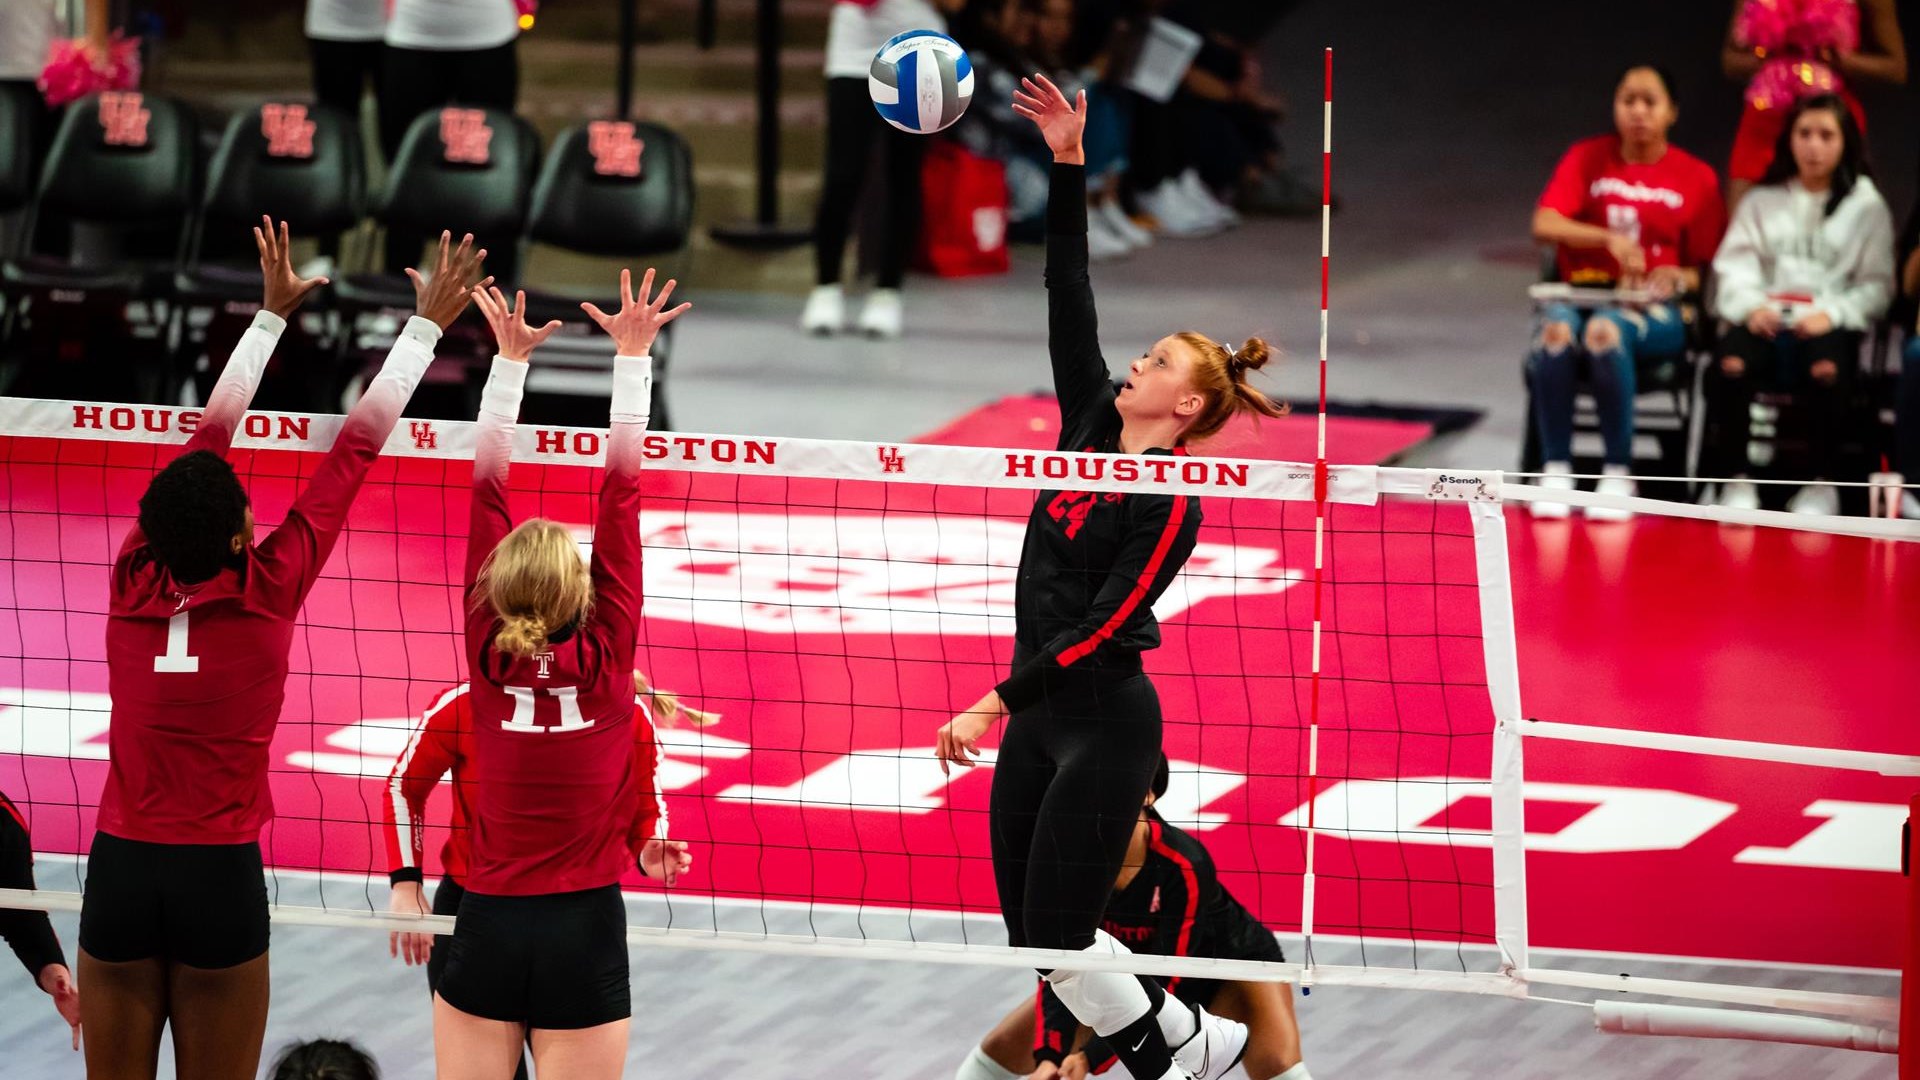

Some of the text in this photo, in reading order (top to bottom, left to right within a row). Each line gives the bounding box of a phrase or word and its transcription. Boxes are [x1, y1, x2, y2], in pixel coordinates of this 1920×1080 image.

[73, 405, 311, 441] HOUSON
[410, 422, 437, 449] UH
[536, 429, 777, 464] HOSTON
[878, 446, 905, 473] UH
[1005, 453, 1249, 487] HOUSTON
[1449, 476, 1482, 485] Senoh
[153, 610, 199, 673] 1
[531, 651, 555, 679] T
[501, 685, 596, 733] 11
